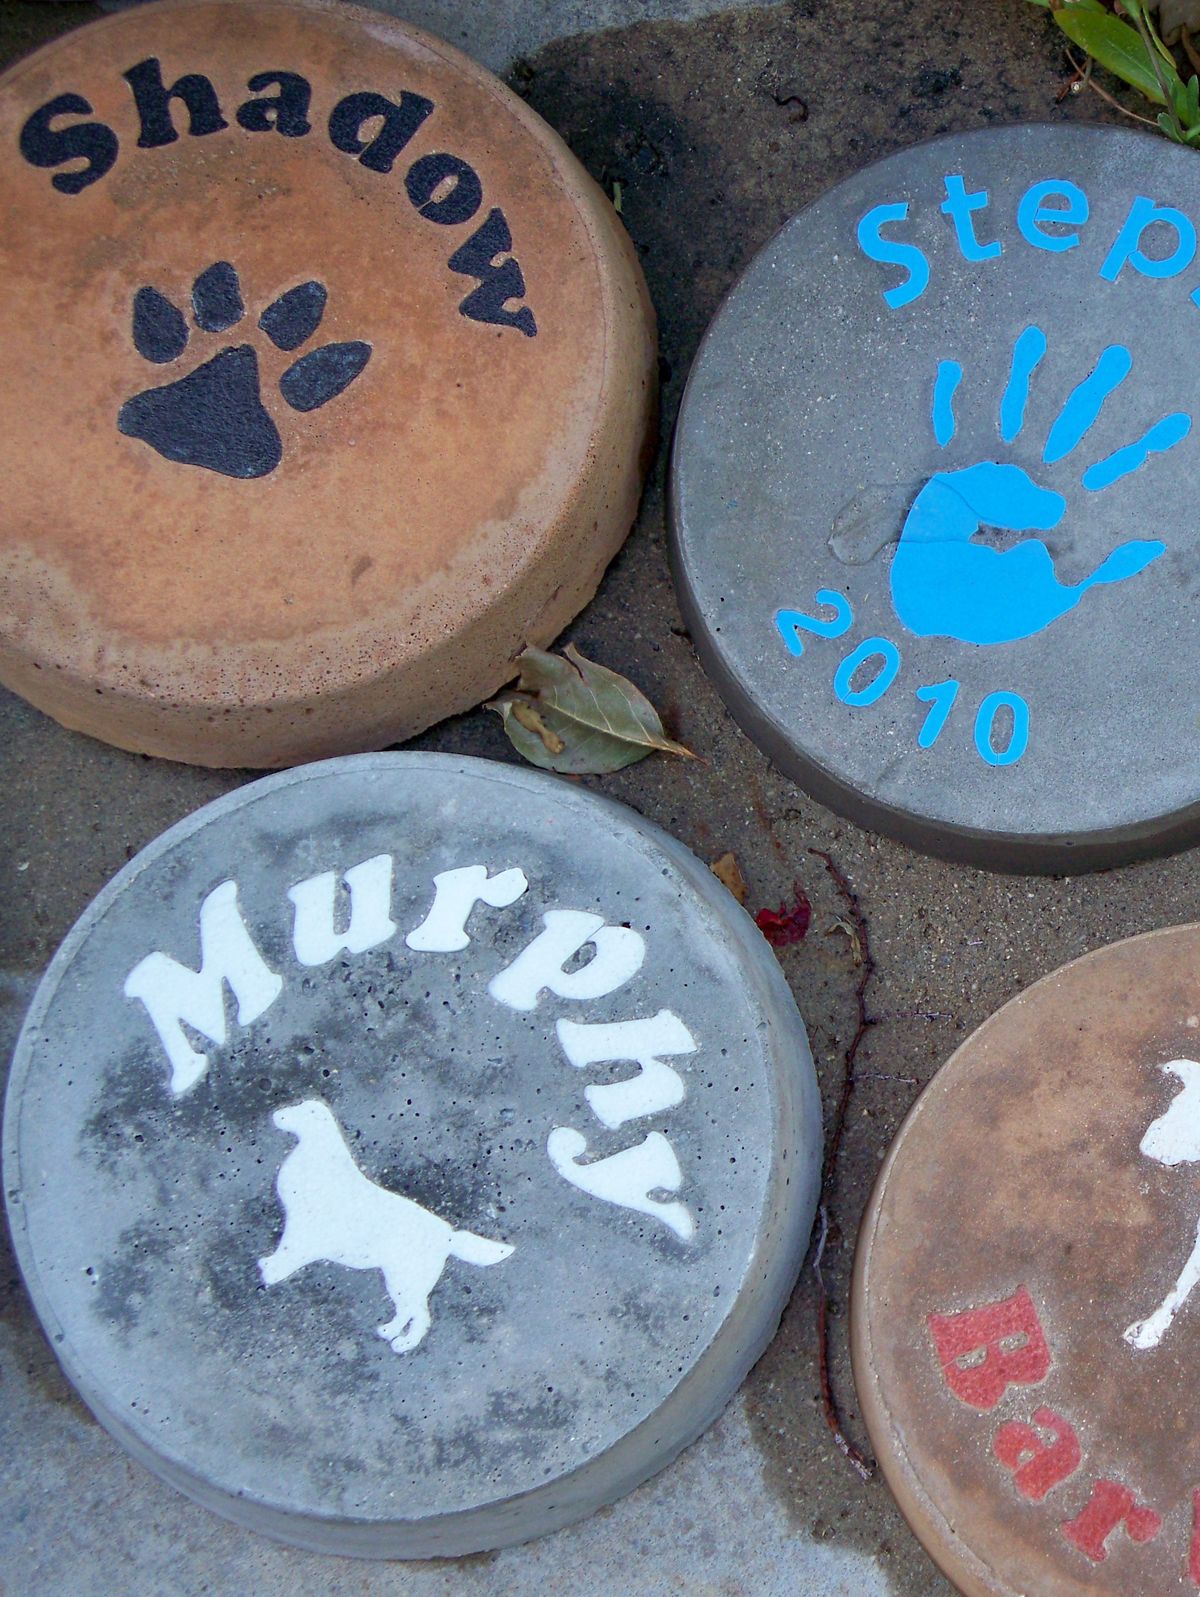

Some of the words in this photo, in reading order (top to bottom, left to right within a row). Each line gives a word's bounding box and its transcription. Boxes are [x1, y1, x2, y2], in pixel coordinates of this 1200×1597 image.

[19, 56, 538, 338] Shadow
[775, 587, 1031, 767] 2010
[124, 853, 699, 1243] Murphy
